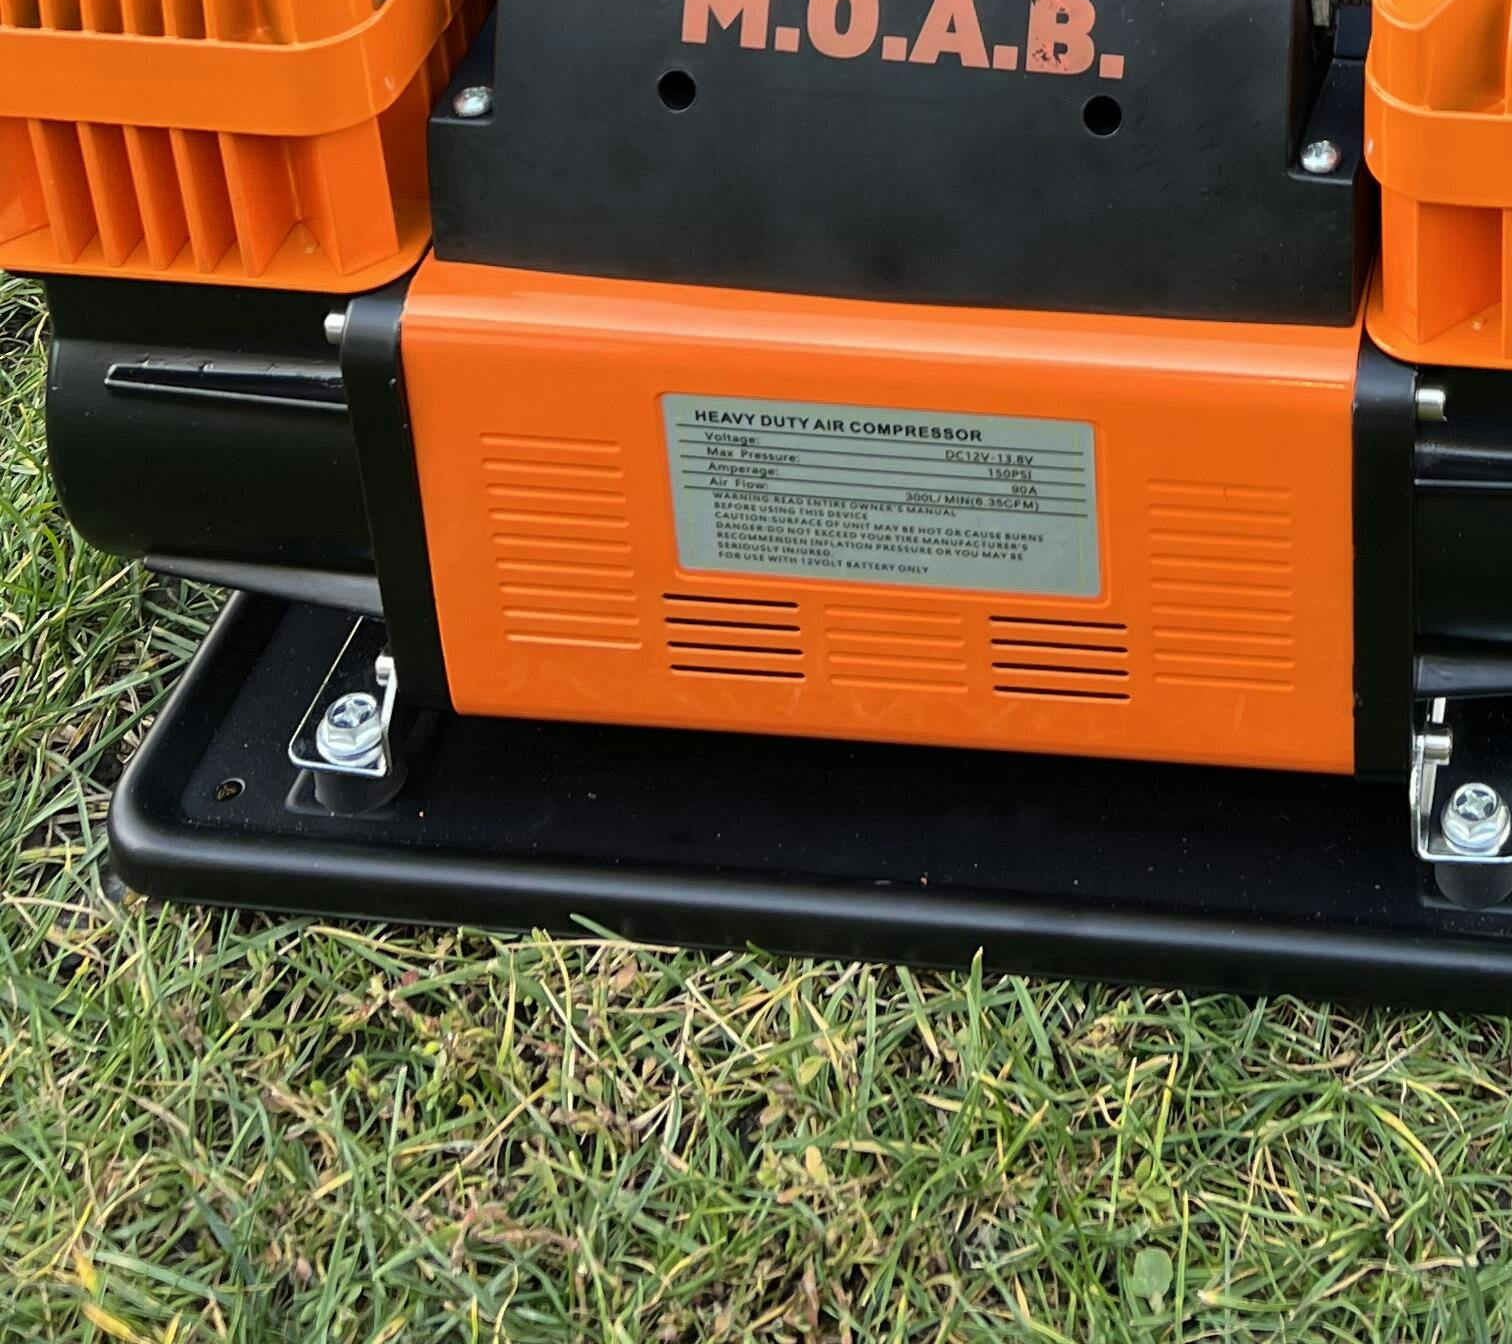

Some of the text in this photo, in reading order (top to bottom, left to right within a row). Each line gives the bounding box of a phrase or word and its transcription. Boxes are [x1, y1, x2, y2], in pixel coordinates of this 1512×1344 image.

[695, 409, 983, 442] HEAVY DUTY AIR COMPRESSOR
[704, 431, 760, 447] Voltage:
[706, 447, 1033, 480] Max Pressure: 150PSI
[708, 462, 1038, 495] Amperage: 90A
[709, 476, 728, 487] Air
[735, 478, 769, 490] Flow:
[714, 502, 869, 520] BEFORE USING THIS DEVICE
[807, 498, 847, 509] ENTIRE
[850, 500, 904, 513] OWNER'S
[907, 507, 957, 517] MANUAL
[787, 526, 811, 536] NOT
[815, 528, 857, 539] EXCEED
[861, 531, 892, 542] YOUR
[895, 534, 919, 544] TIRE
[922, 537, 1028, 551] MANUFACTURER'S
[825, 520, 840, 528] OF
[843, 521, 871, 531] UNIT
[874, 523, 899, 533] MAY
[902, 525, 916, 534] BE
[919, 527, 942, 536] HOT
[946, 528, 962, 537] OR
[964, 530, 1001, 540] CAUSE
[1005, 532, 1044, 543] BURNS
[718, 541, 779, 553] SERIOUSLY
[810, 537, 873, 551] INFLATION
[876, 543, 933, 555] PRESSURE
[935, 547, 952, 556] OR
[955, 549, 979, 559] YOU
[982, 551, 1007, 560] MAY
[718, 550, 929, 574] FOR USE WITH 12VOLT BATTERY ONLY
